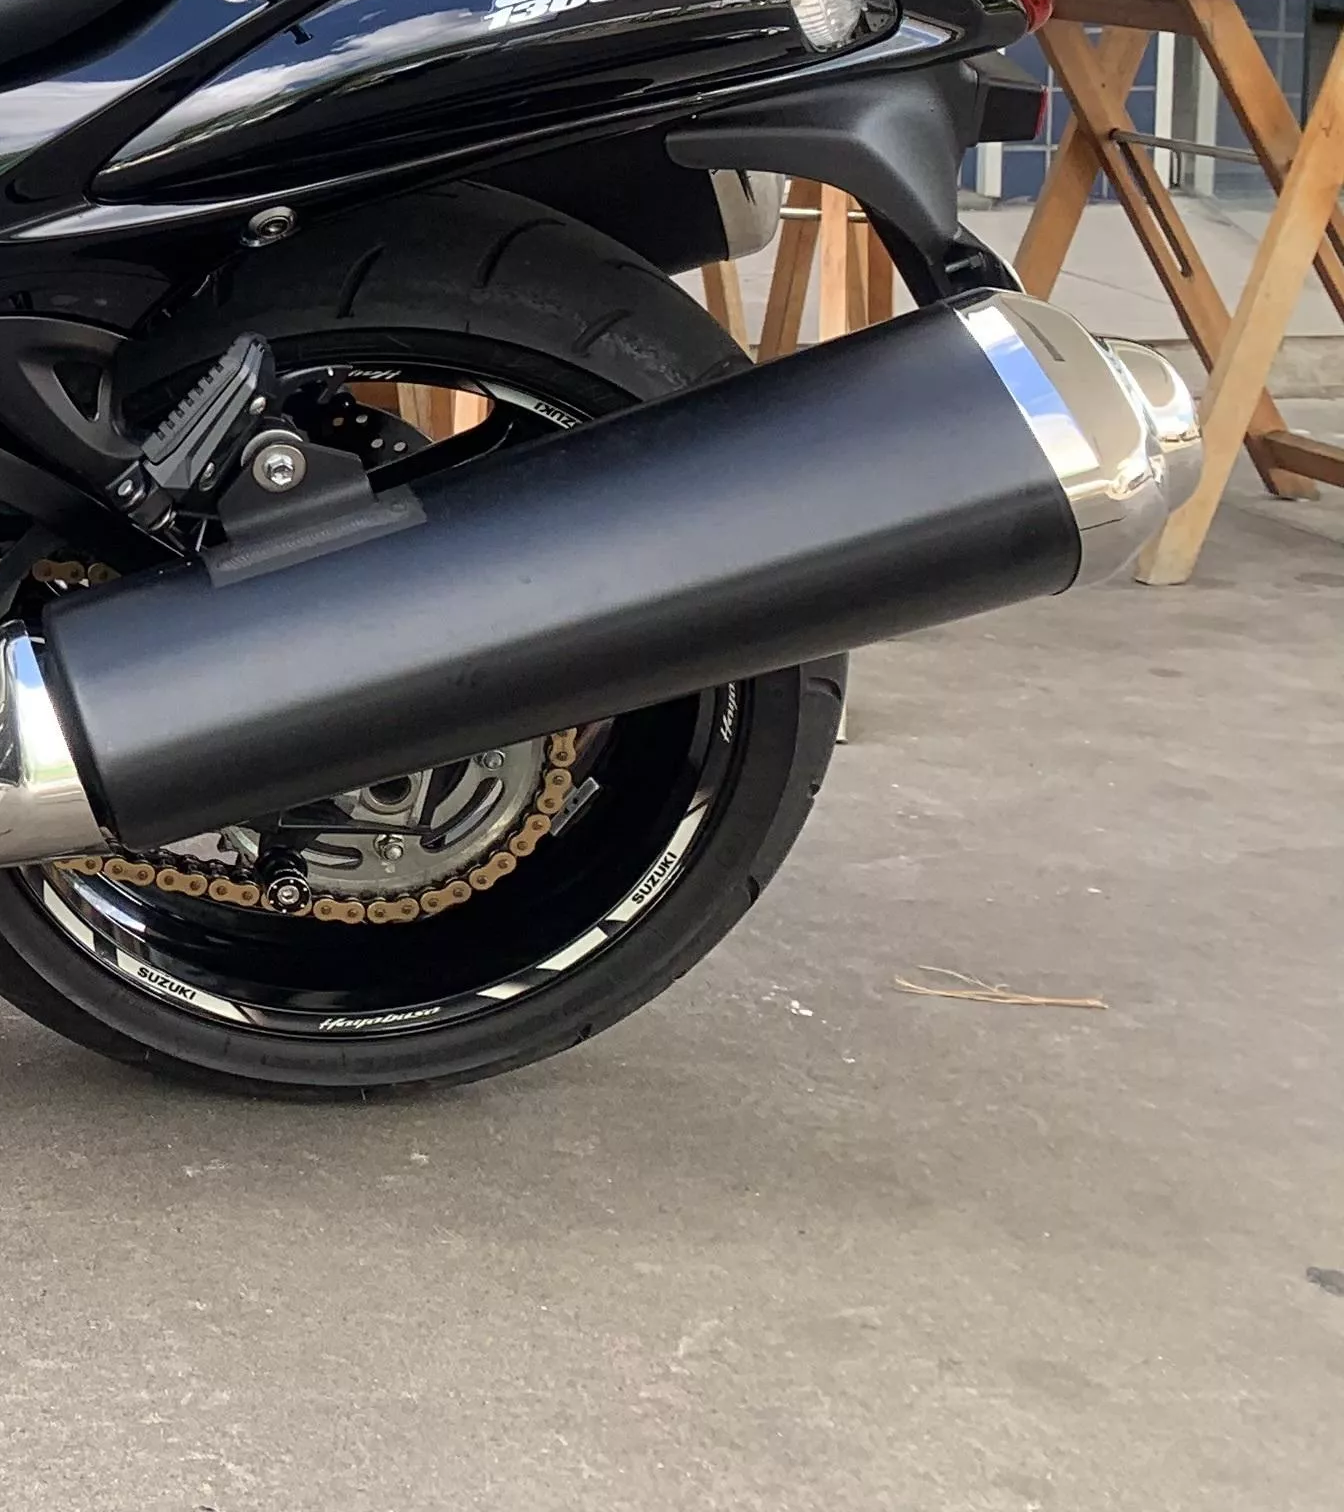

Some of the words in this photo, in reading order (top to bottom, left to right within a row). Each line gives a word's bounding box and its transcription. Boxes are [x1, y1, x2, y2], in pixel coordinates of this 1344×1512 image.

[533, 401, 578, 430] ZUKI
[631, 851, 678, 905] SUZUKI
[137, 966, 197, 1001] SUZUKI
